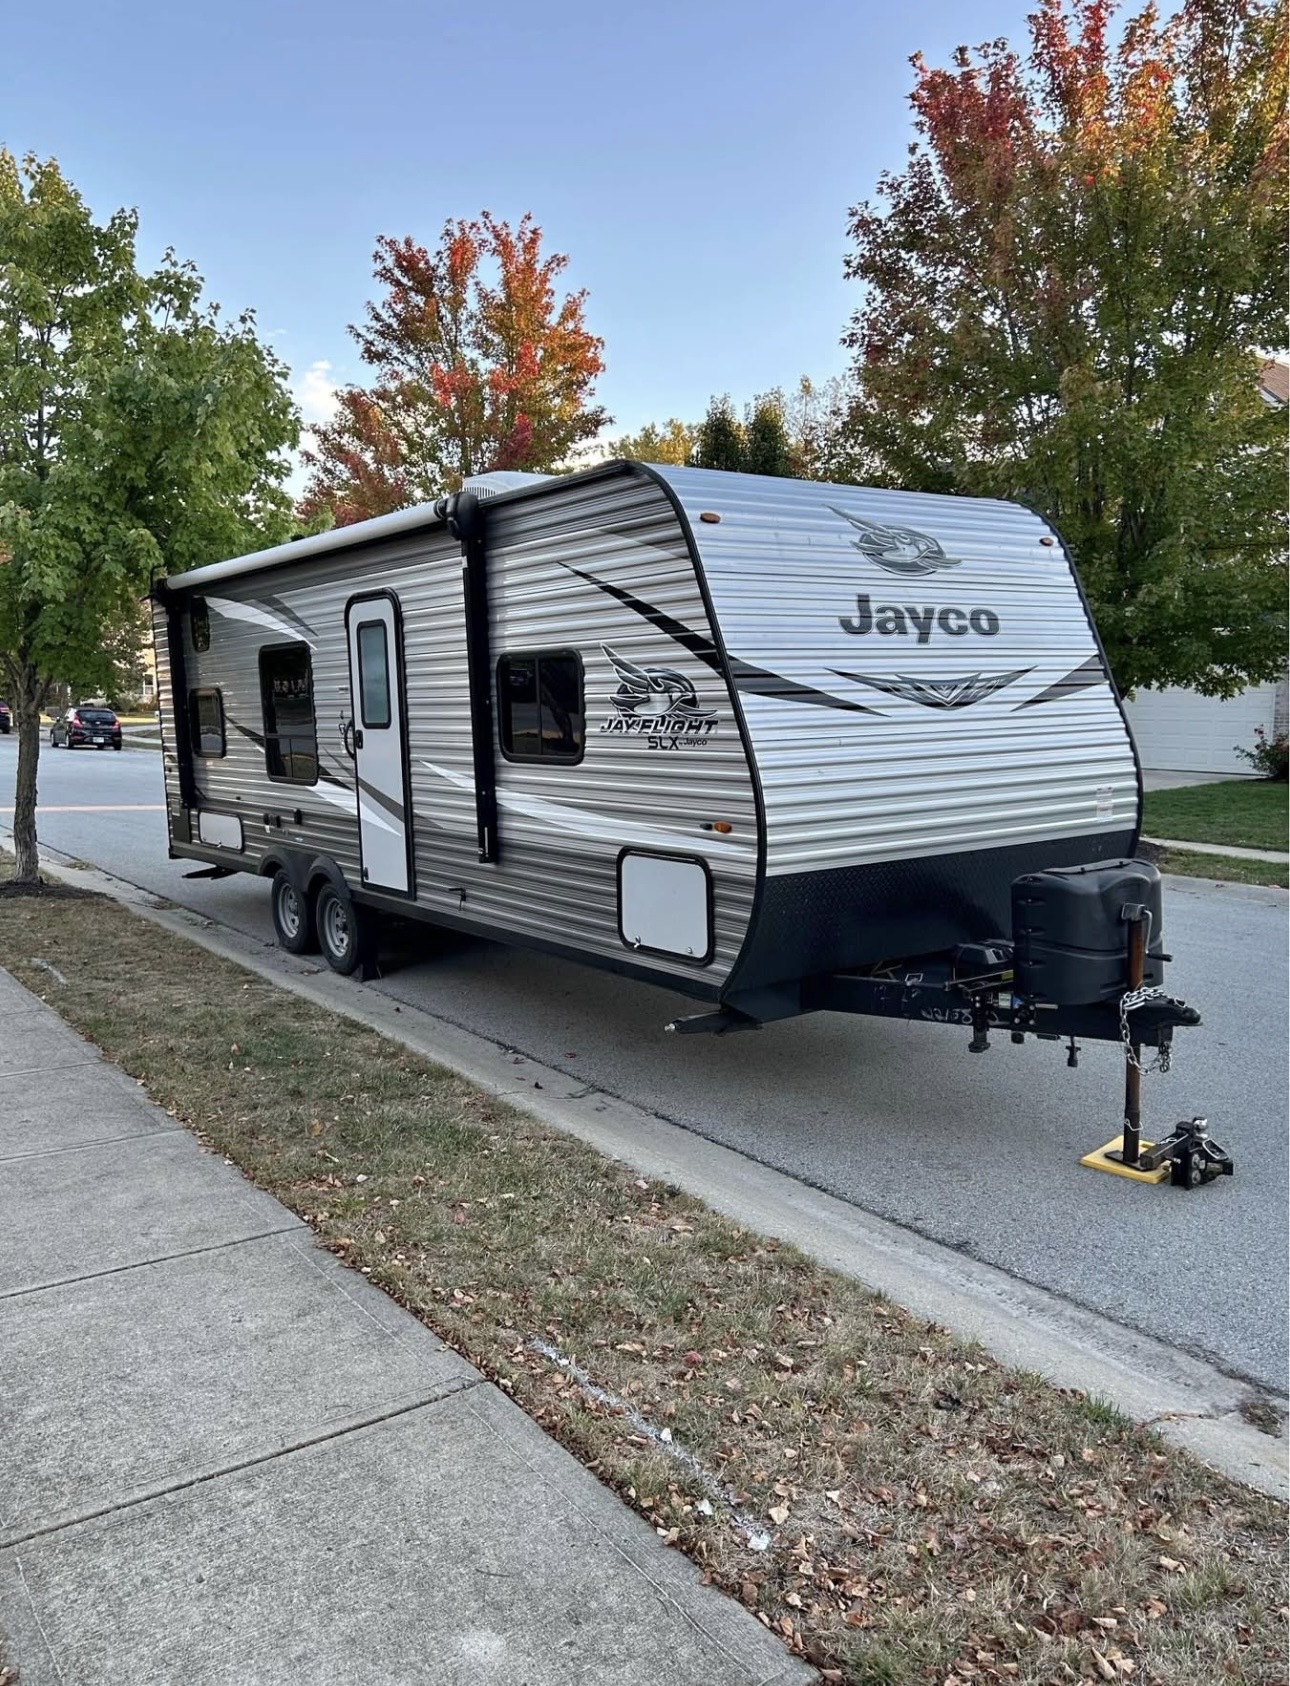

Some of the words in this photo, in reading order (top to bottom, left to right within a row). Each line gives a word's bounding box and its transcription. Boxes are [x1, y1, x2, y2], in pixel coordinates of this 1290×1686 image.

[839, 594, 1001, 645] Jayco
[600, 717, 637, 733] JAY
[638, 718, 718, 734] FLIGHT
[648, 736, 680, 750] SLX
[684, 738, 708, 747] Jayco
